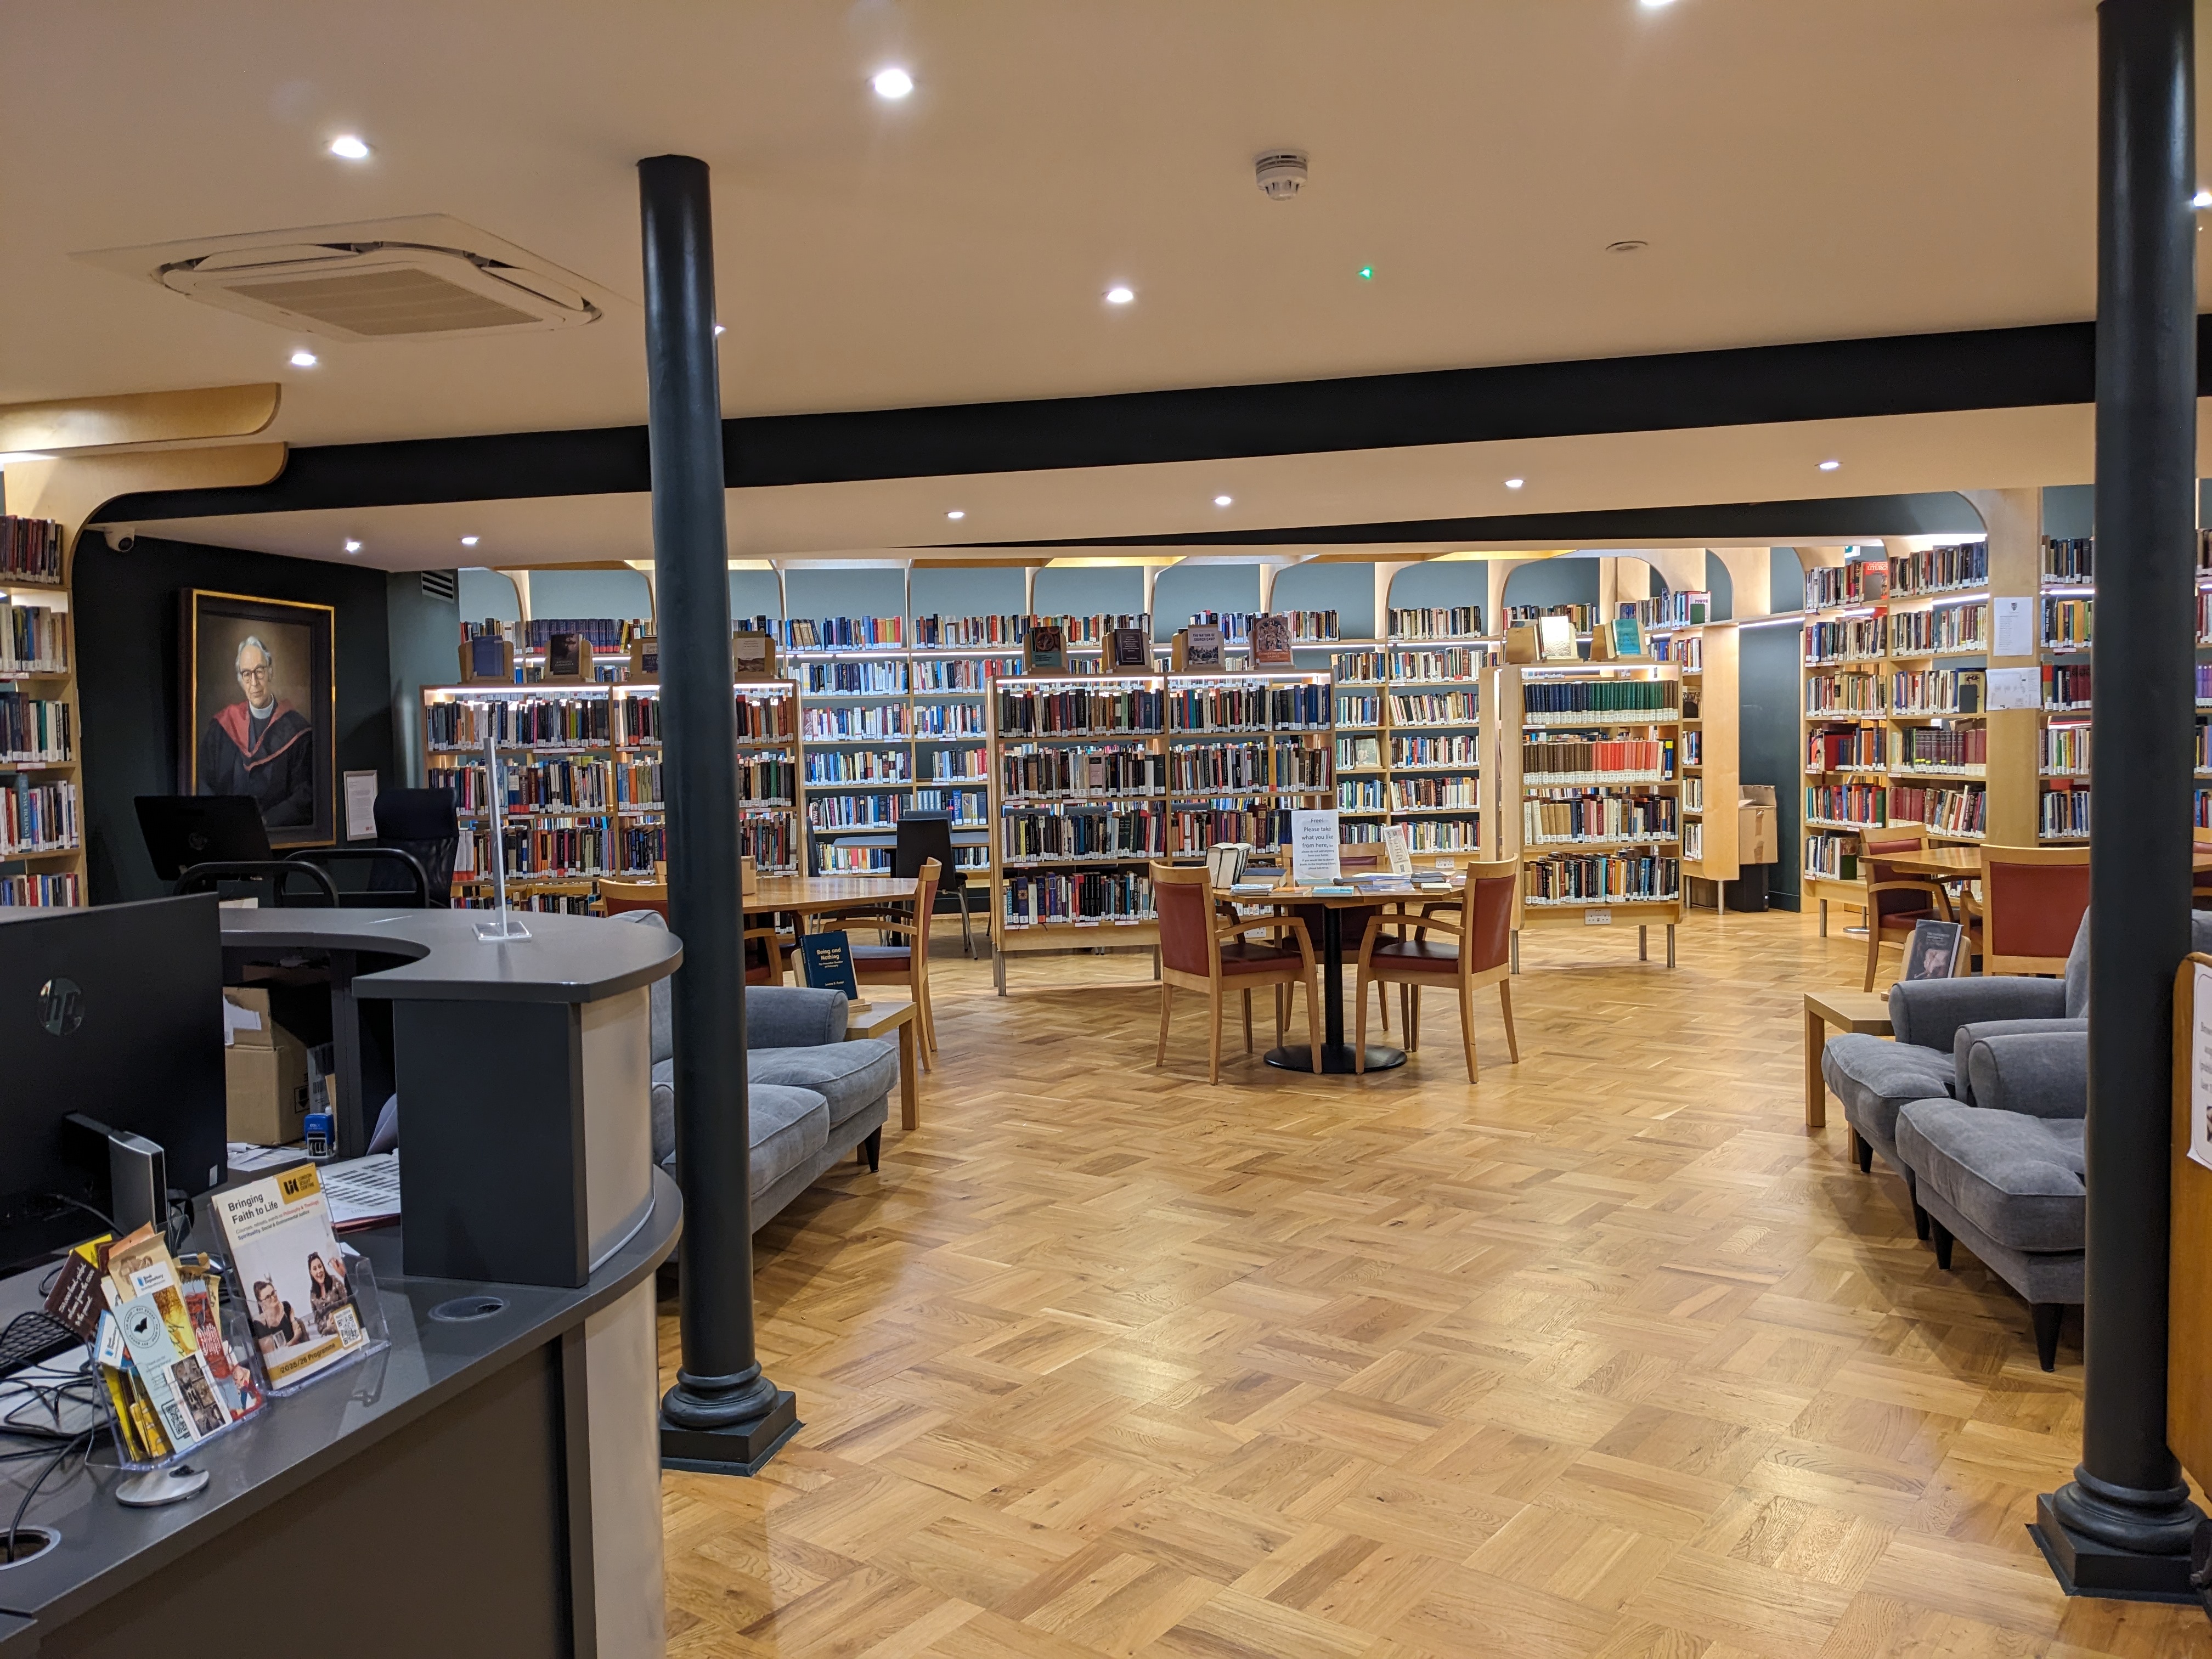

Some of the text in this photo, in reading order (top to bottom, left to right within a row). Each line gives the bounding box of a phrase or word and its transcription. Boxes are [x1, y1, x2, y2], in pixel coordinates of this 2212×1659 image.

[228, 1194, 264, 1211] Bringing
[232, 1210, 255, 1224] Faith
[264, 1200, 278, 1212] Life
[238, 1229, 261, 1241] Spirituality,
[145, 1274, 163, 1284] Depository
[280, 1343, 335, 1374] 2025/26 Programme
